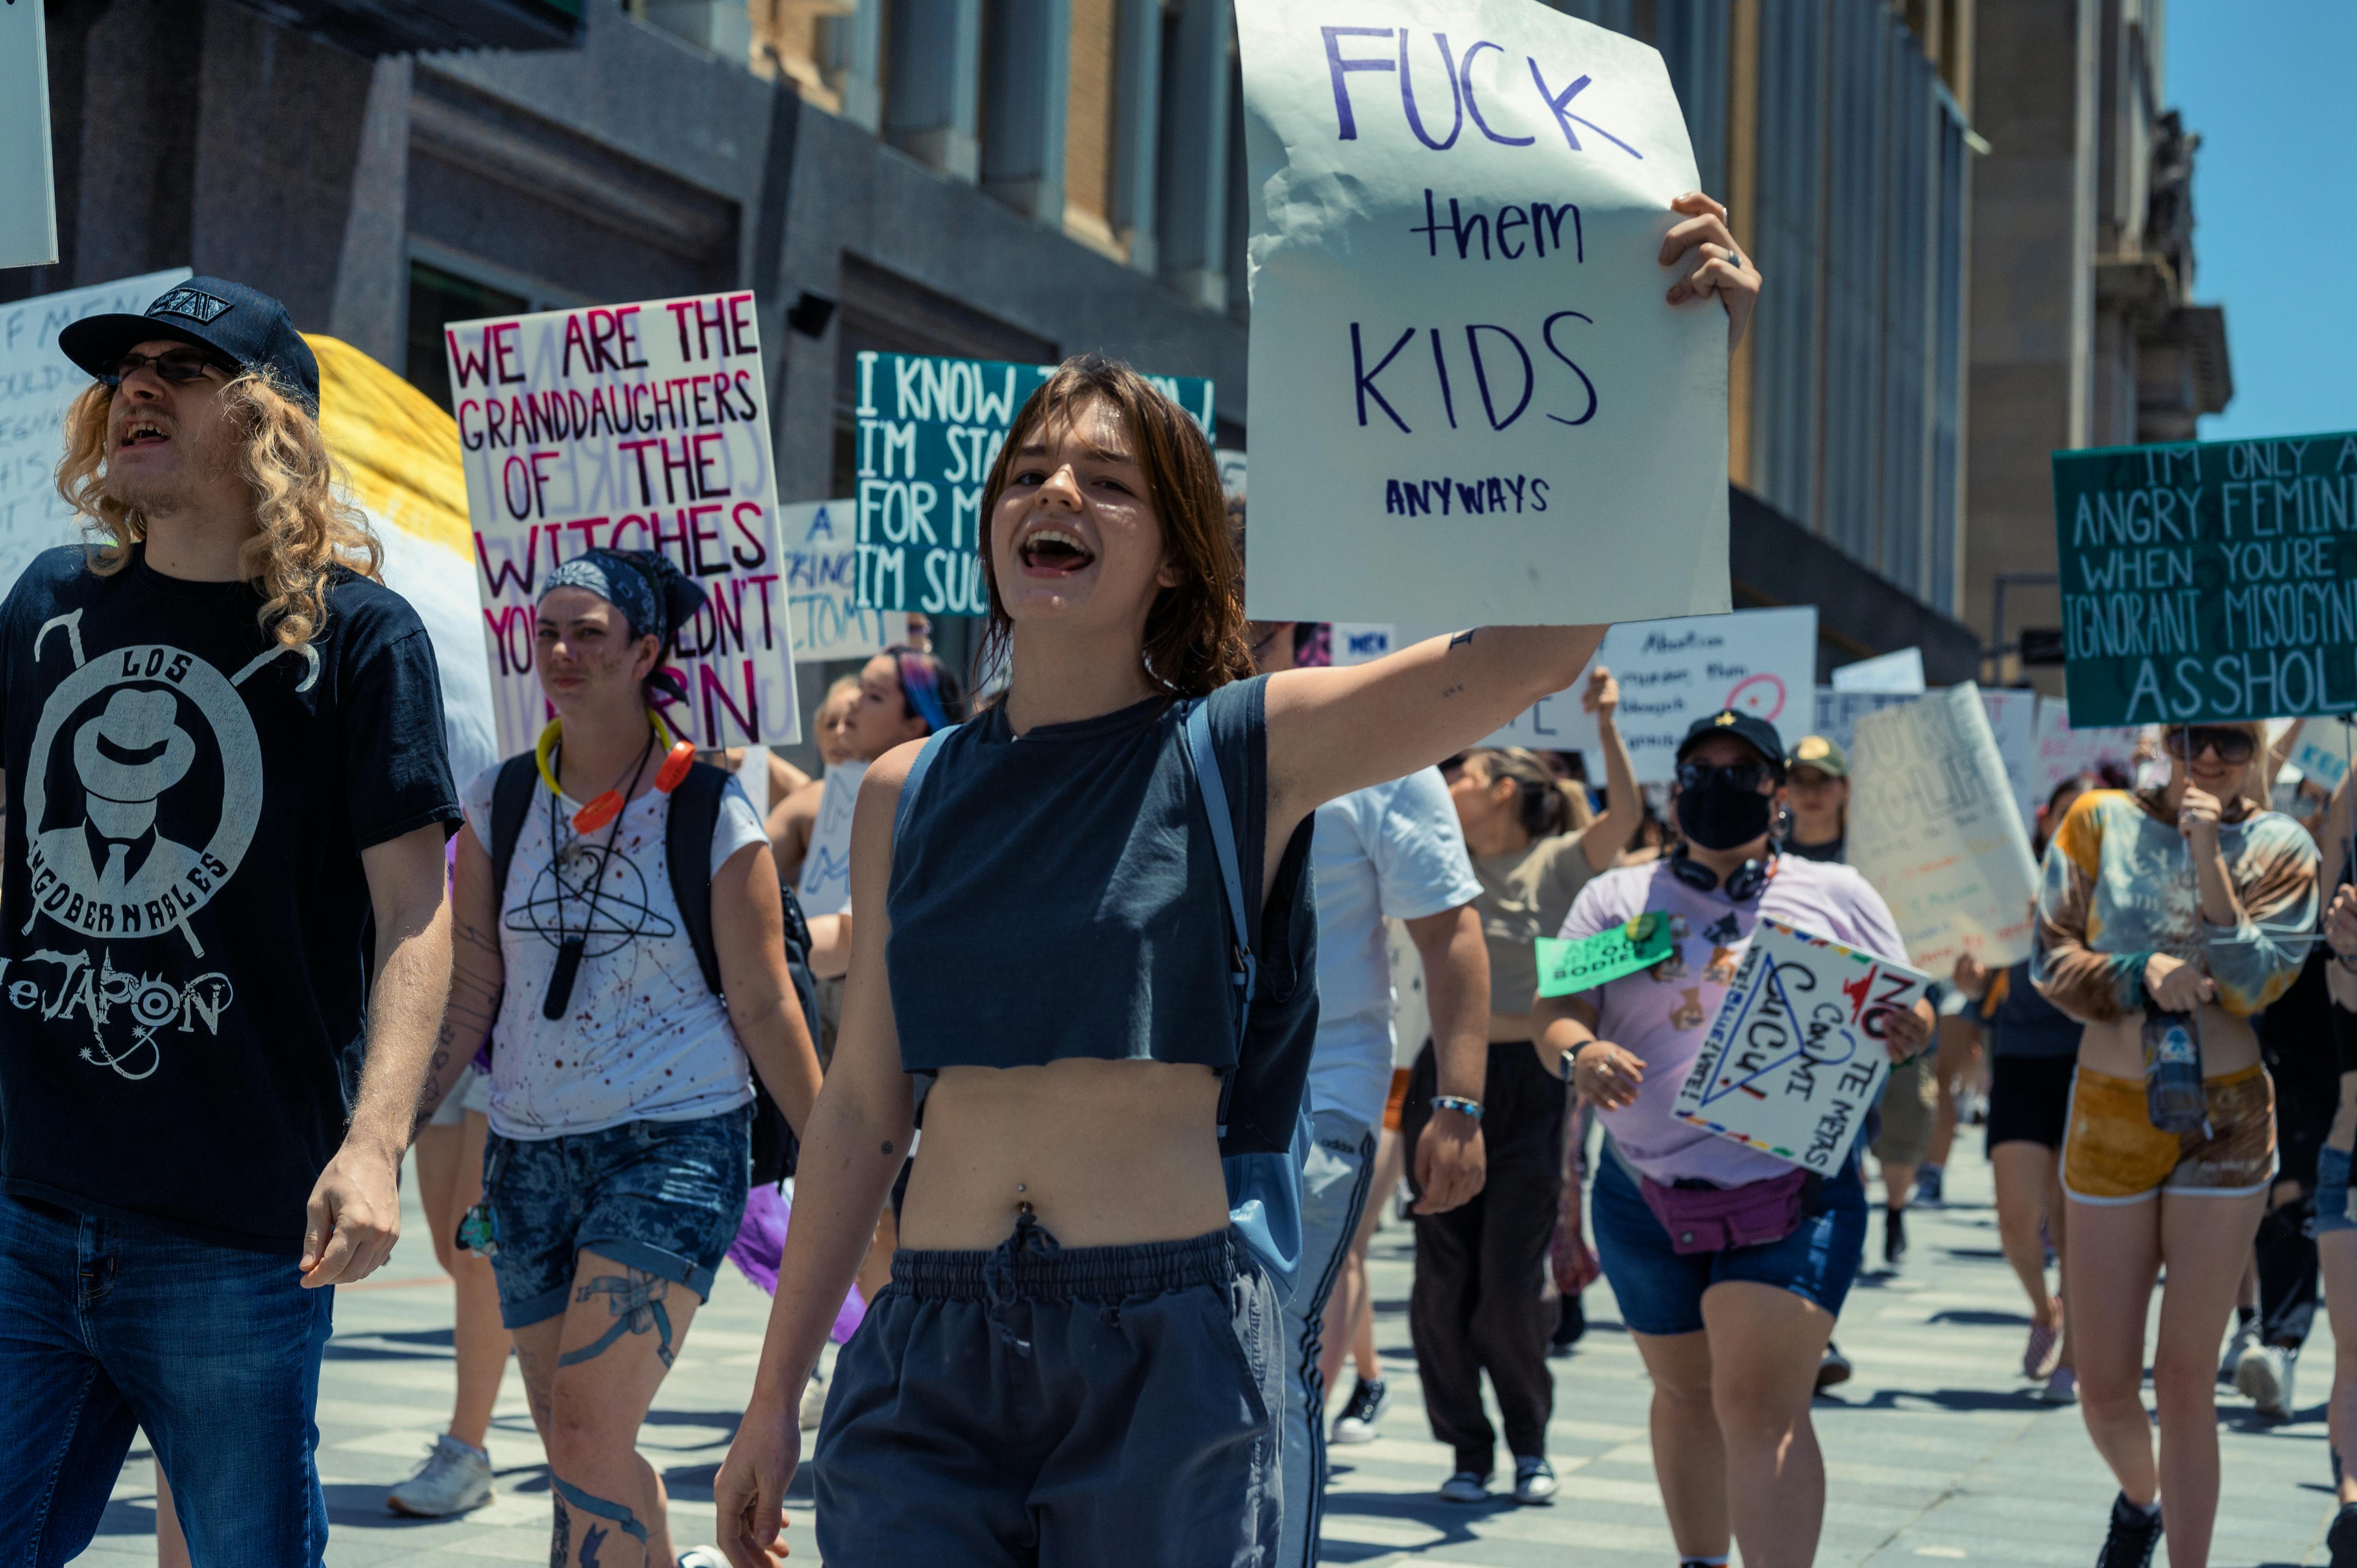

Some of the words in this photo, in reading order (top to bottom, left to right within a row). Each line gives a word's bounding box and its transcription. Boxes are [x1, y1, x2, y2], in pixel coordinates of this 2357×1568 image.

[1321, 25, 1643, 159] FUCK
[1409, 188, 1583, 263] them
[445, 321, 526, 388] WE
[563, 306, 649, 377] ARE
[666, 294, 758, 362] THE
[1350, 310, 1599, 434] KIDS
[459, 369, 757, 451] GRANDDAUGHTERS
[856, 351, 878, 417] I
[894, 355, 1017, 425] KNOW
[503, 451, 559, 521] OF
[618, 432, 731, 506] THE
[858, 419, 916, 480] I'M
[944, 424, 1010, 483] STA
[2228, 440, 2309, 480] ONLY
[860, 478, 938, 546] FOR
[1386, 474, 1550, 517] ANYWAYS
[2073, 486, 2204, 548] ANGRY
[856, 543, 905, 610] I'M
[2079, 547, 2194, 591] WHEN
[2218, 535, 2337, 583] YOU'RE
[484, 605, 536, 676] YO
[2064, 588, 2201, 661] IGNORANT
[2224, 578, 2357, 651] MISOGYN
[121, 649, 193, 684] LOS
[2125, 645, 2357, 723] ASSHOL
[1553, 948, 1644, 980] BODIE
[1837, 1059, 1880, 1098] TE
